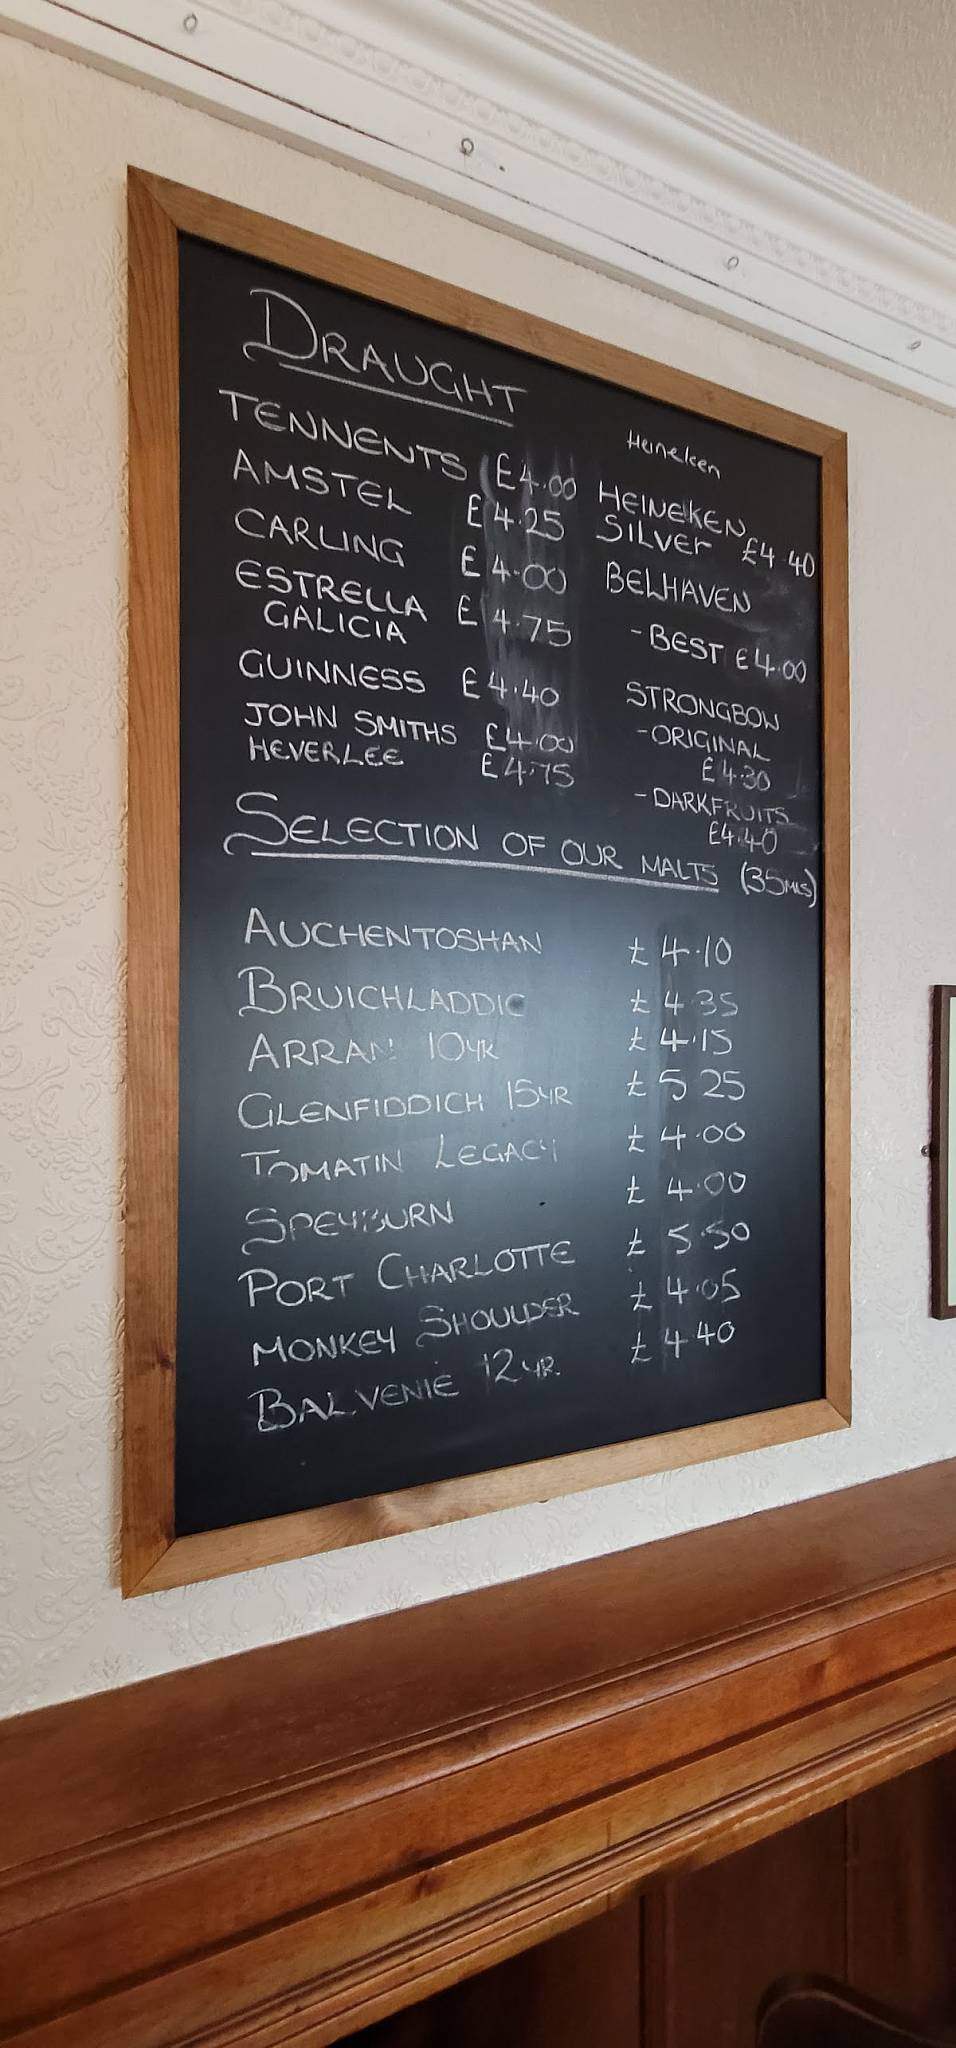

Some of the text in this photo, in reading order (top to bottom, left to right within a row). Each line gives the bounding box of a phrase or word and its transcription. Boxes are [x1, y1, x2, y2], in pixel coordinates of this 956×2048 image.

[242, 289, 528, 413] DRAUGHT
[219, 388, 467, 481] TENNENTS
[232, 449, 412, 515] AMSTEL
[598, 480, 747, 538] HEINEKEN
[234, 508, 406, 568] CARLING
[235, 560, 428, 622] ESTRELLA
[606, 561, 752, 613] BELHAVEN
[263, 601, 407, 644] GALICIA
[238, 650, 426, 693] GUINNESS
[244, 702, 337, 730] JOHN
[354, 711, 458, 745] SMITHS
[626, 681, 781, 732] STRONGBOW
[249, 736, 404, 767] HEVERLEE
[223, 791, 479, 856] SELECTION
[502, 831, 546, 857] OF
[560, 838, 623, 870] OUR
[641, 855, 720, 886] MALTS
[244, 907, 543, 955] AUCHENTOSHAN
[237, 965, 526, 1017] BRUICHLADDIC
[238, 1091, 484, 1129] GLENFIDDICH
[240, 1148, 403, 1183] TOMATIN
[238, 1267, 354, 1307] PORT
[377, 1240, 576, 1291] CHARLOTTE
[252, 1325, 398, 1367] MONKEY
[416, 1292, 580, 1348] SHOULDER
